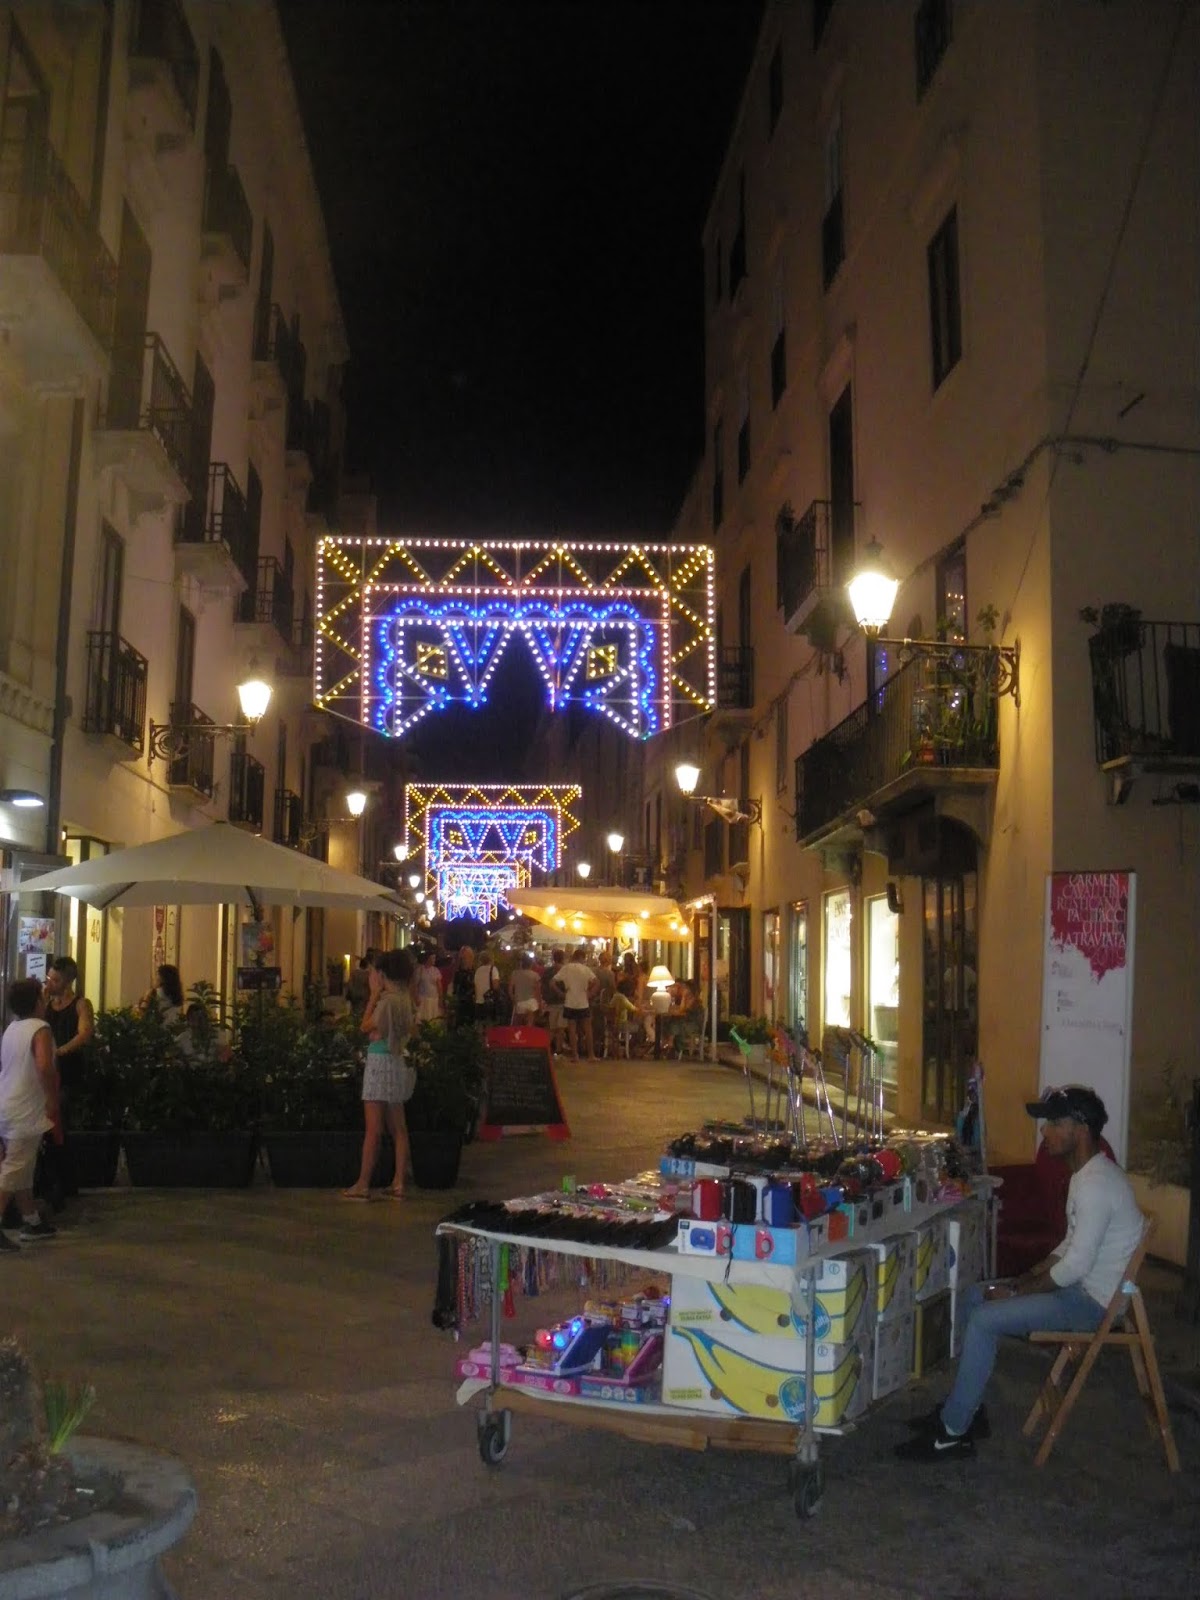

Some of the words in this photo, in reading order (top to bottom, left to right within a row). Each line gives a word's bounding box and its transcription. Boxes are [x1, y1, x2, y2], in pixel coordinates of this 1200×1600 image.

[1069, 873, 1120, 887] CARMEN
[1062, 885, 1129, 899] CAVALLERIA
[1056, 897, 1123, 911] RUSTICANA
[1072, 932, 1127, 947] TRAVIATA
